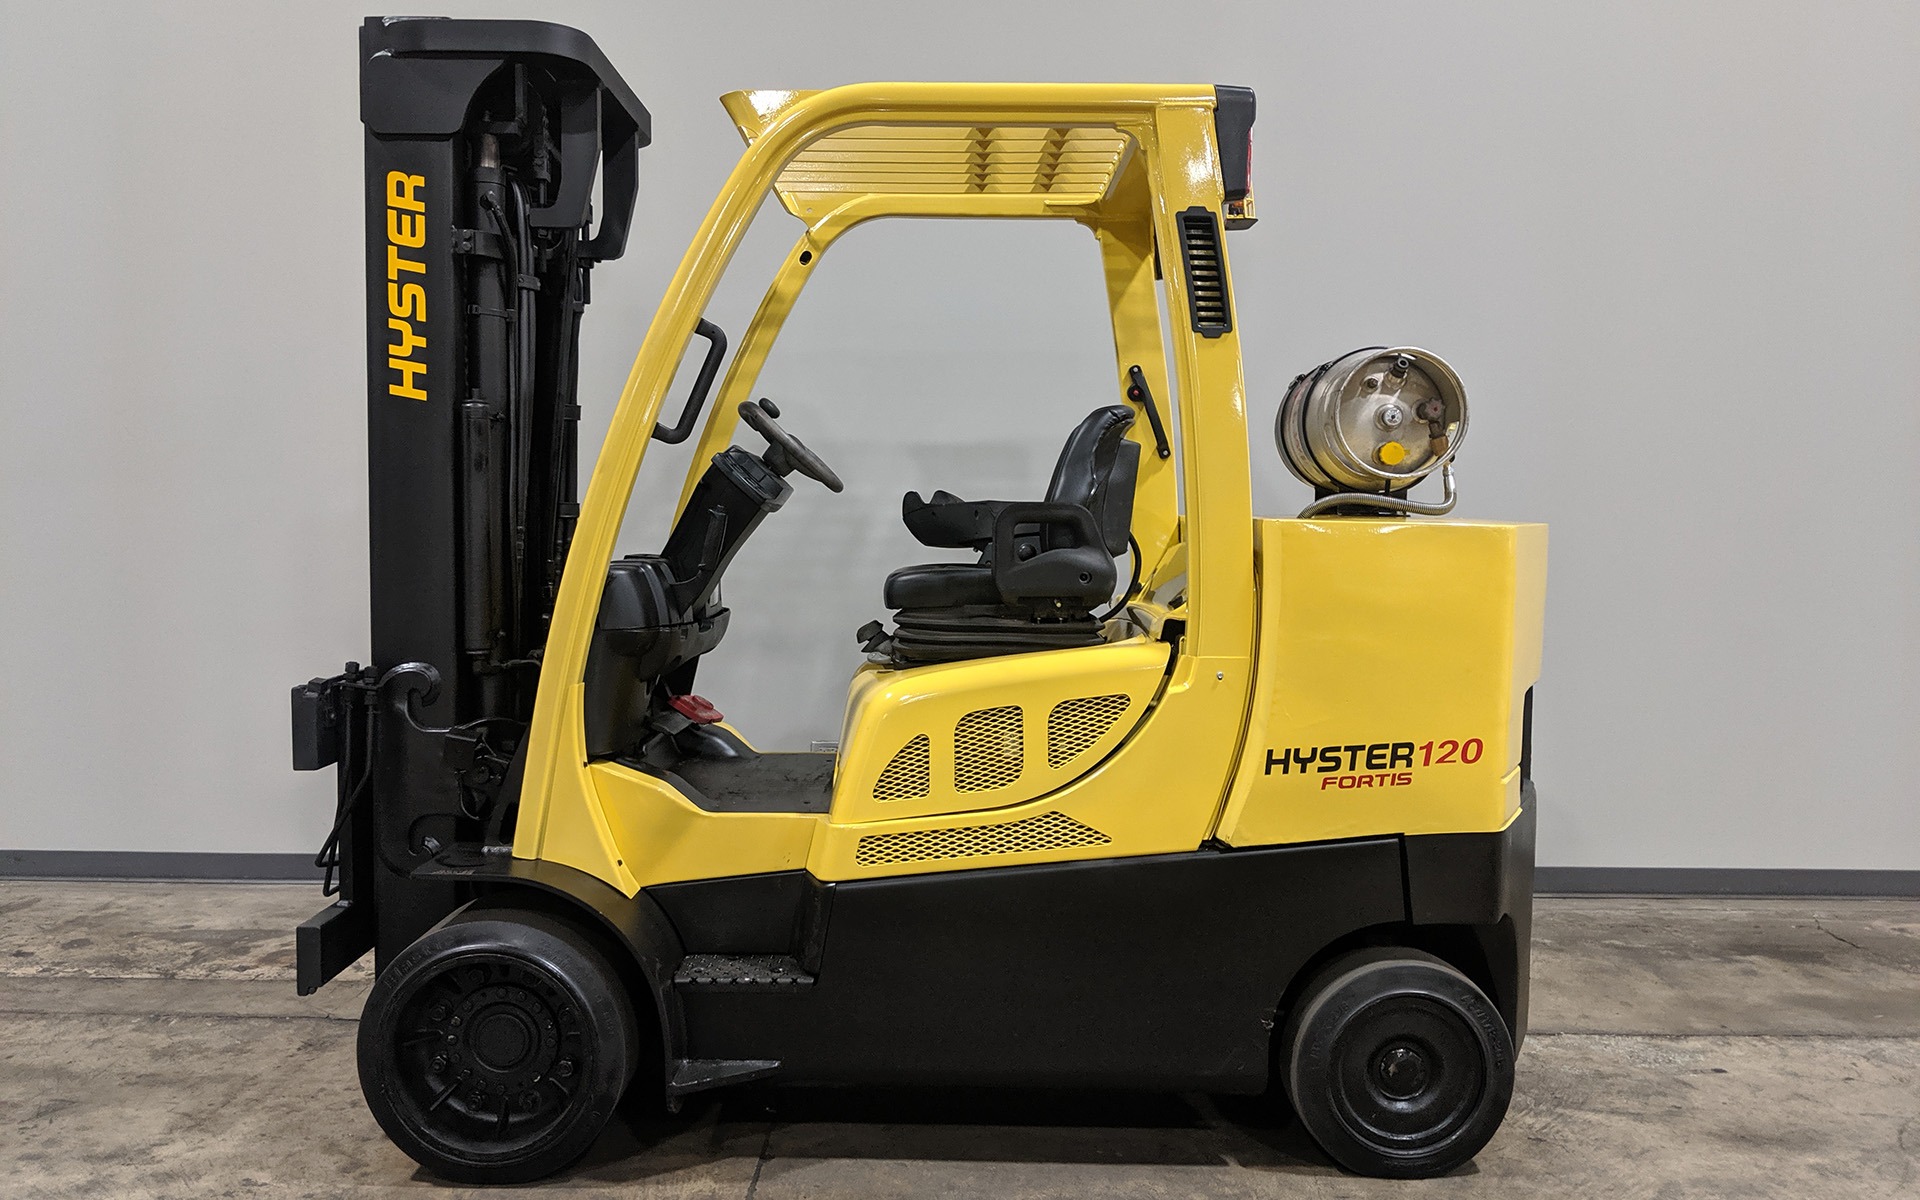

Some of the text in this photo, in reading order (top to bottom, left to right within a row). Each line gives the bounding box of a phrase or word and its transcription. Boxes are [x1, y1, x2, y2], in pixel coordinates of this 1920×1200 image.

[386, 170, 428, 402] HYSTER
[1264, 738, 1484, 776] HYSTER 120
[1320, 772, 1413, 790] FORTIS
